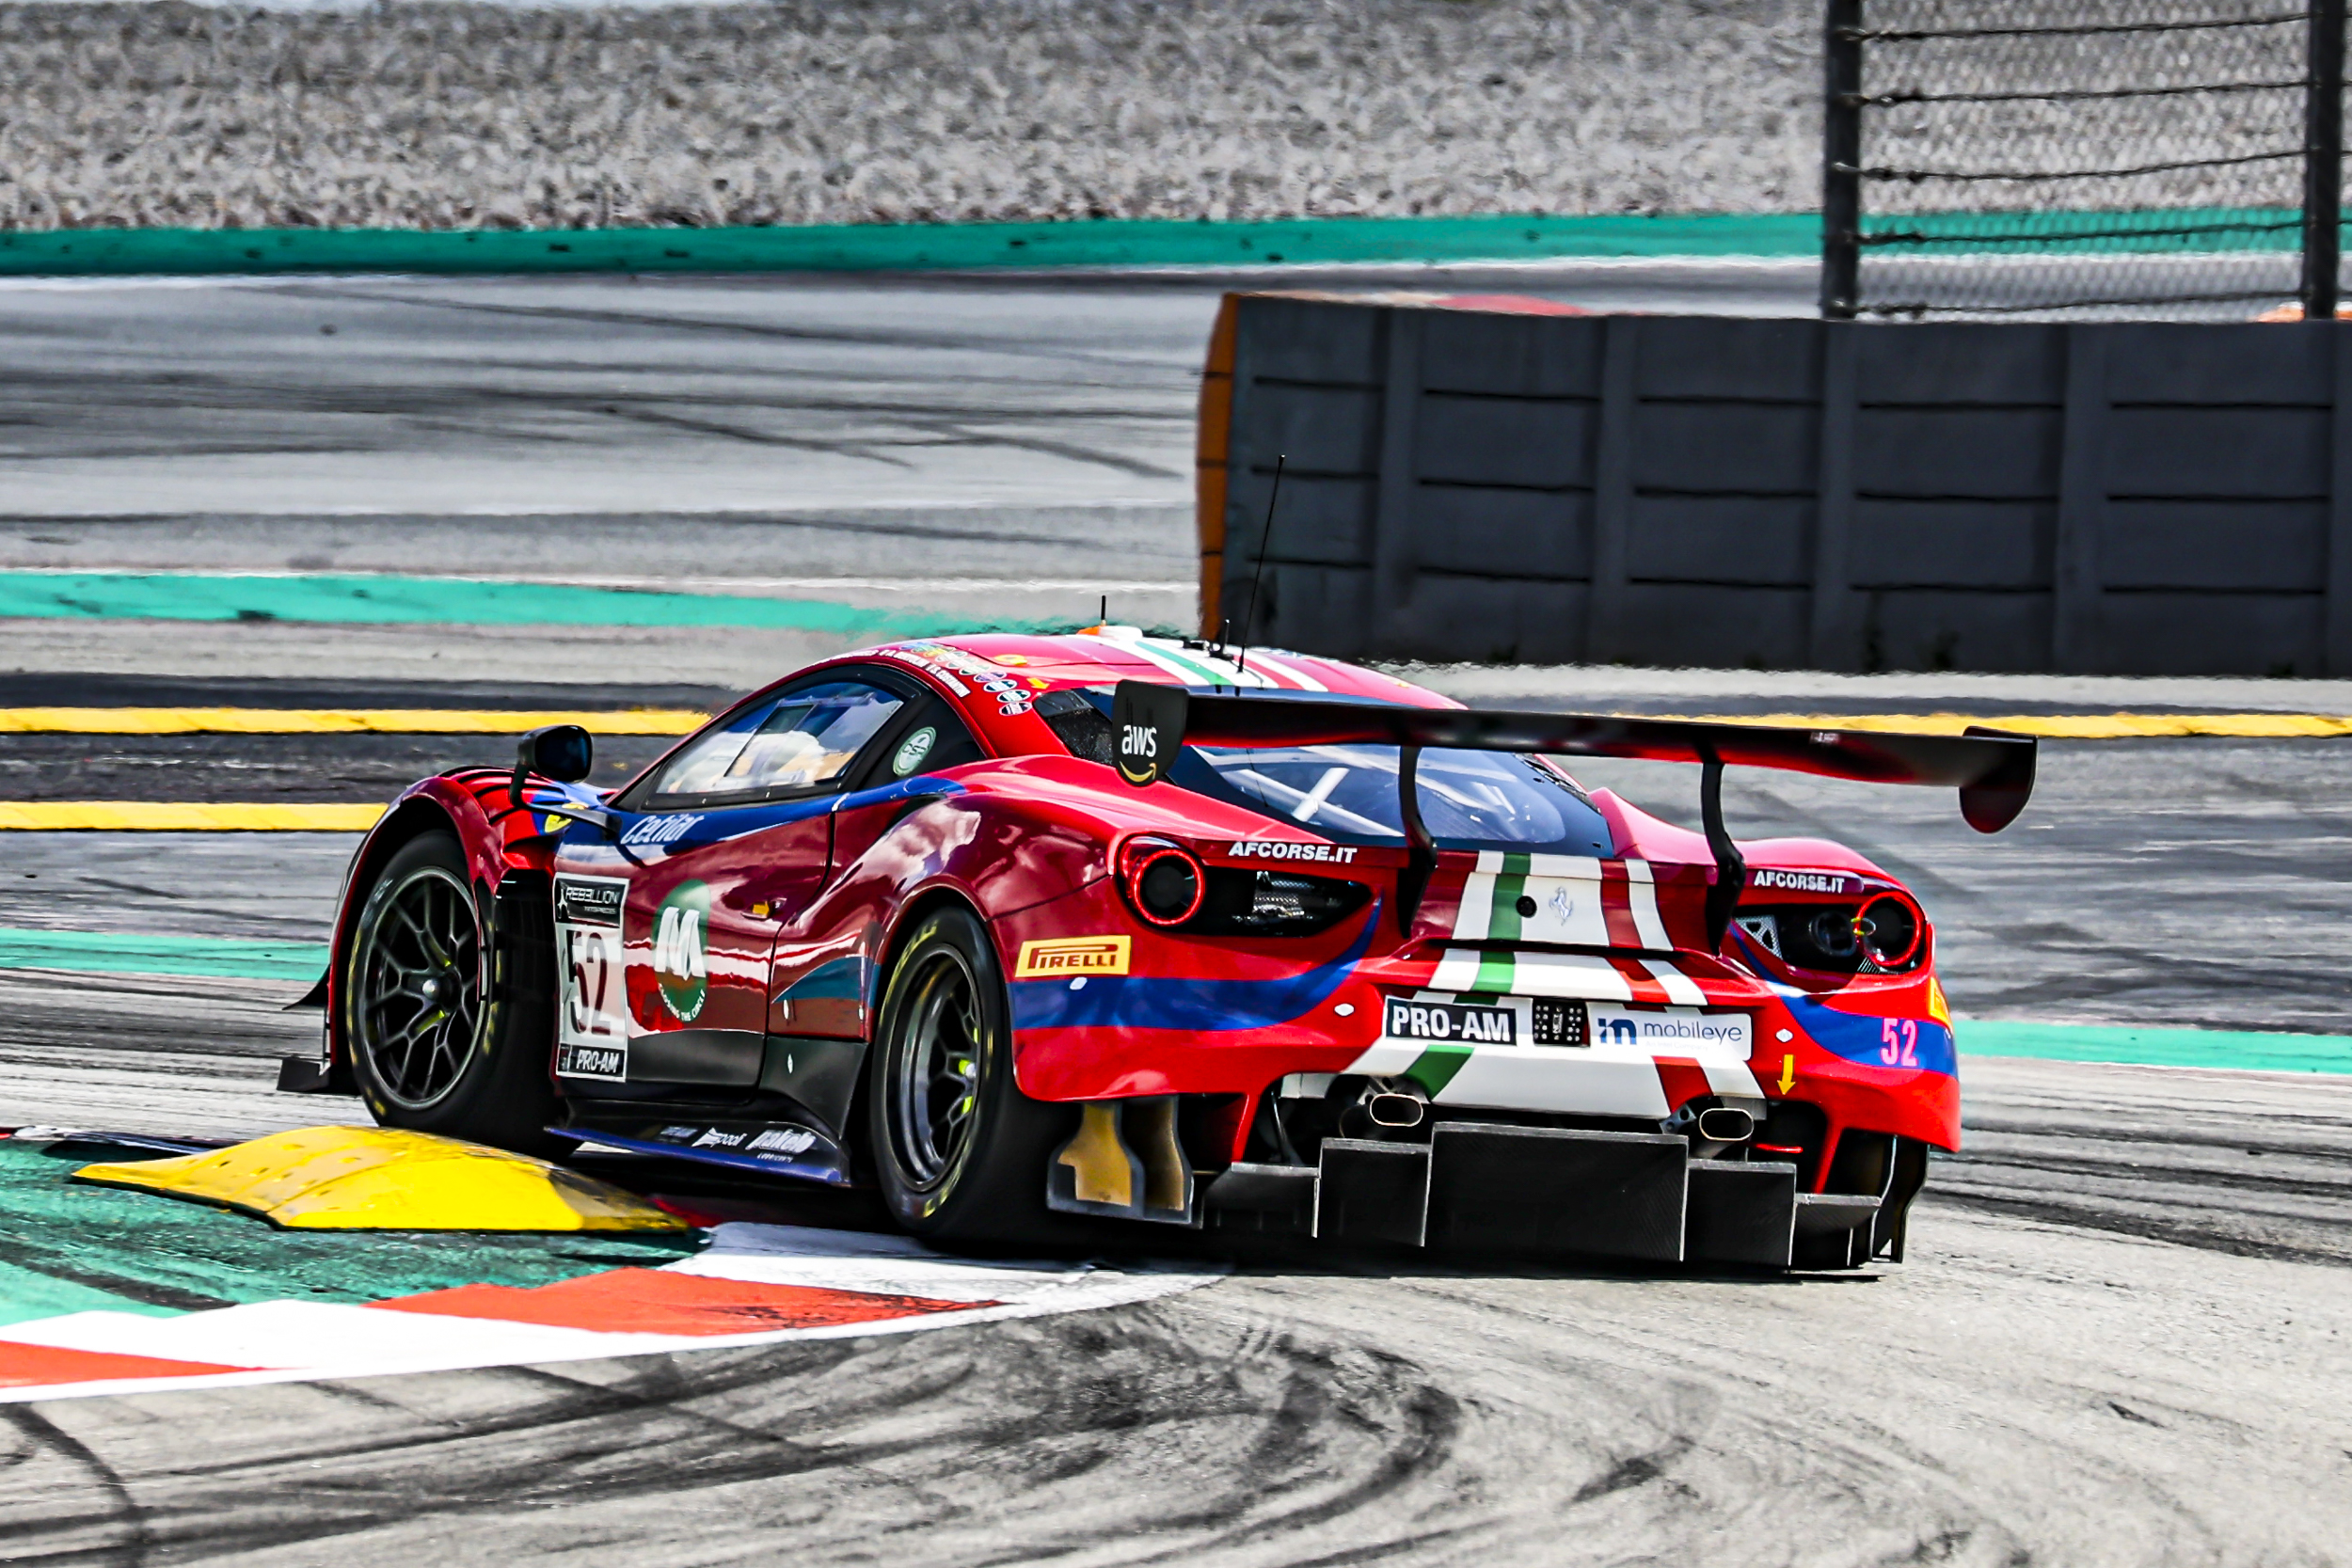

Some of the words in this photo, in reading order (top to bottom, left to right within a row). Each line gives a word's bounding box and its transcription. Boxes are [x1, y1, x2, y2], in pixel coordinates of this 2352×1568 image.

[1120, 724, 1157, 757] aws
[1228, 841, 1358, 863] AFCORSE.IT
[1754, 870, 1845, 894] AFCORSE.IT
[1026, 943, 1119, 970] PIRELLI
[566, 929, 612, 1036] 52
[1392, 1006, 1512, 1042] PRO-AM
[1644, 1019, 1742, 1046] mobileye
[1881, 1017, 1919, 1067] 52
[576, 1049, 620, 1073] PRO-AM
